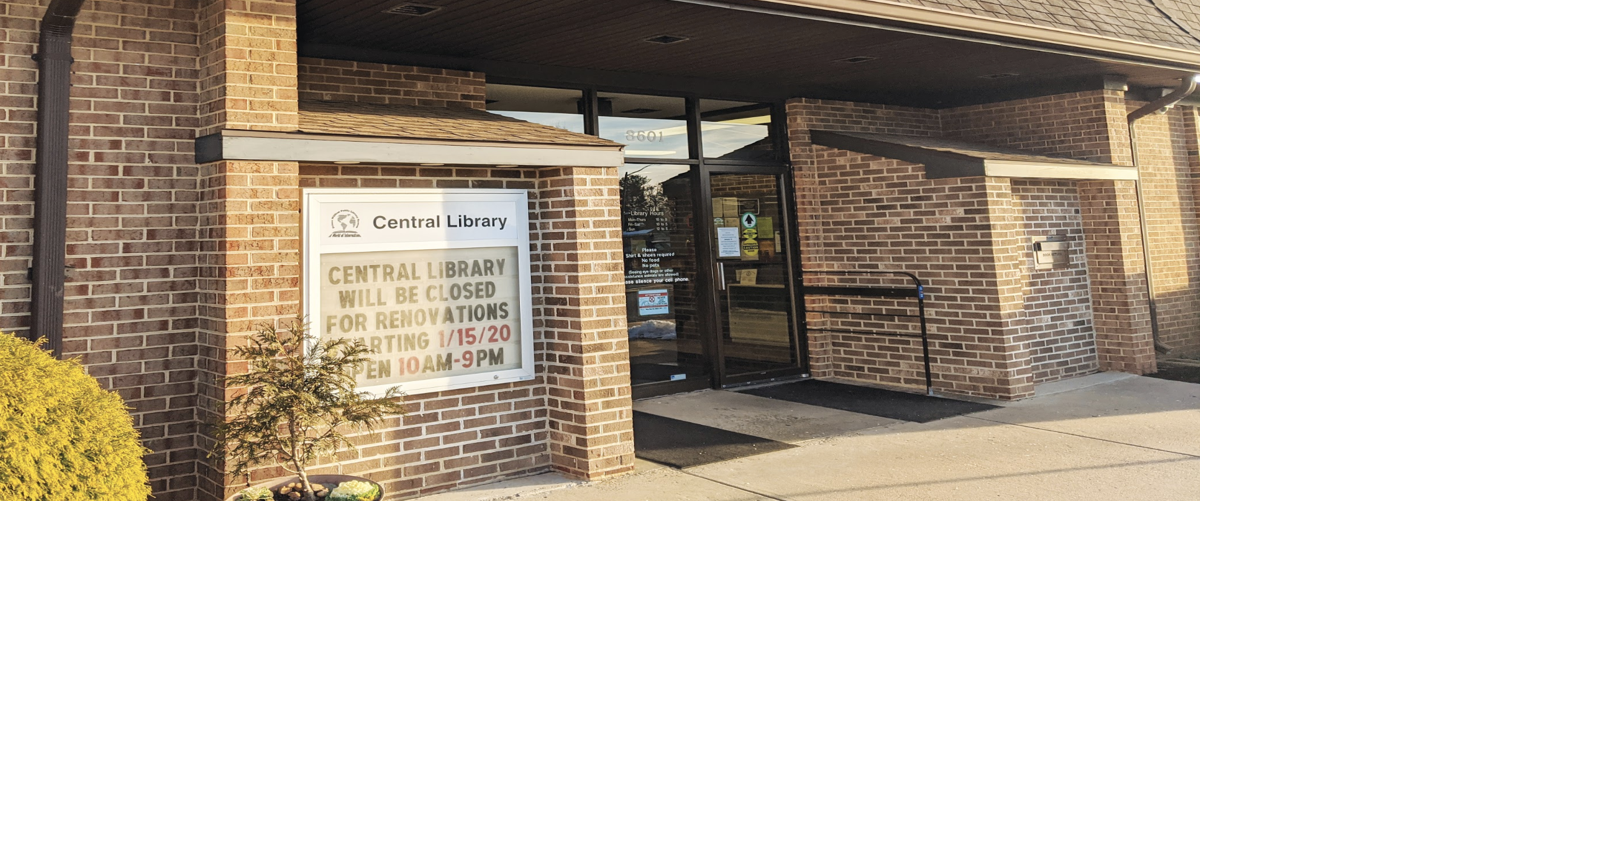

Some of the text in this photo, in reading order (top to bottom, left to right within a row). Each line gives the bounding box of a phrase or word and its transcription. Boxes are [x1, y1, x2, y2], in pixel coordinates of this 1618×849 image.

[625, 129, 664, 143] 8601
[372, 215, 441, 230] Central
[446, 214, 508, 231] Library
[328, 258, 506, 286] CENTRAL LIBRARY
[338, 280, 496, 310] WILL BE CLOSED
[326, 301, 509, 335] FOR RENOVATIONS
[438, 323, 512, 349] 1/15/20
[338, 358, 391, 382] PEN
